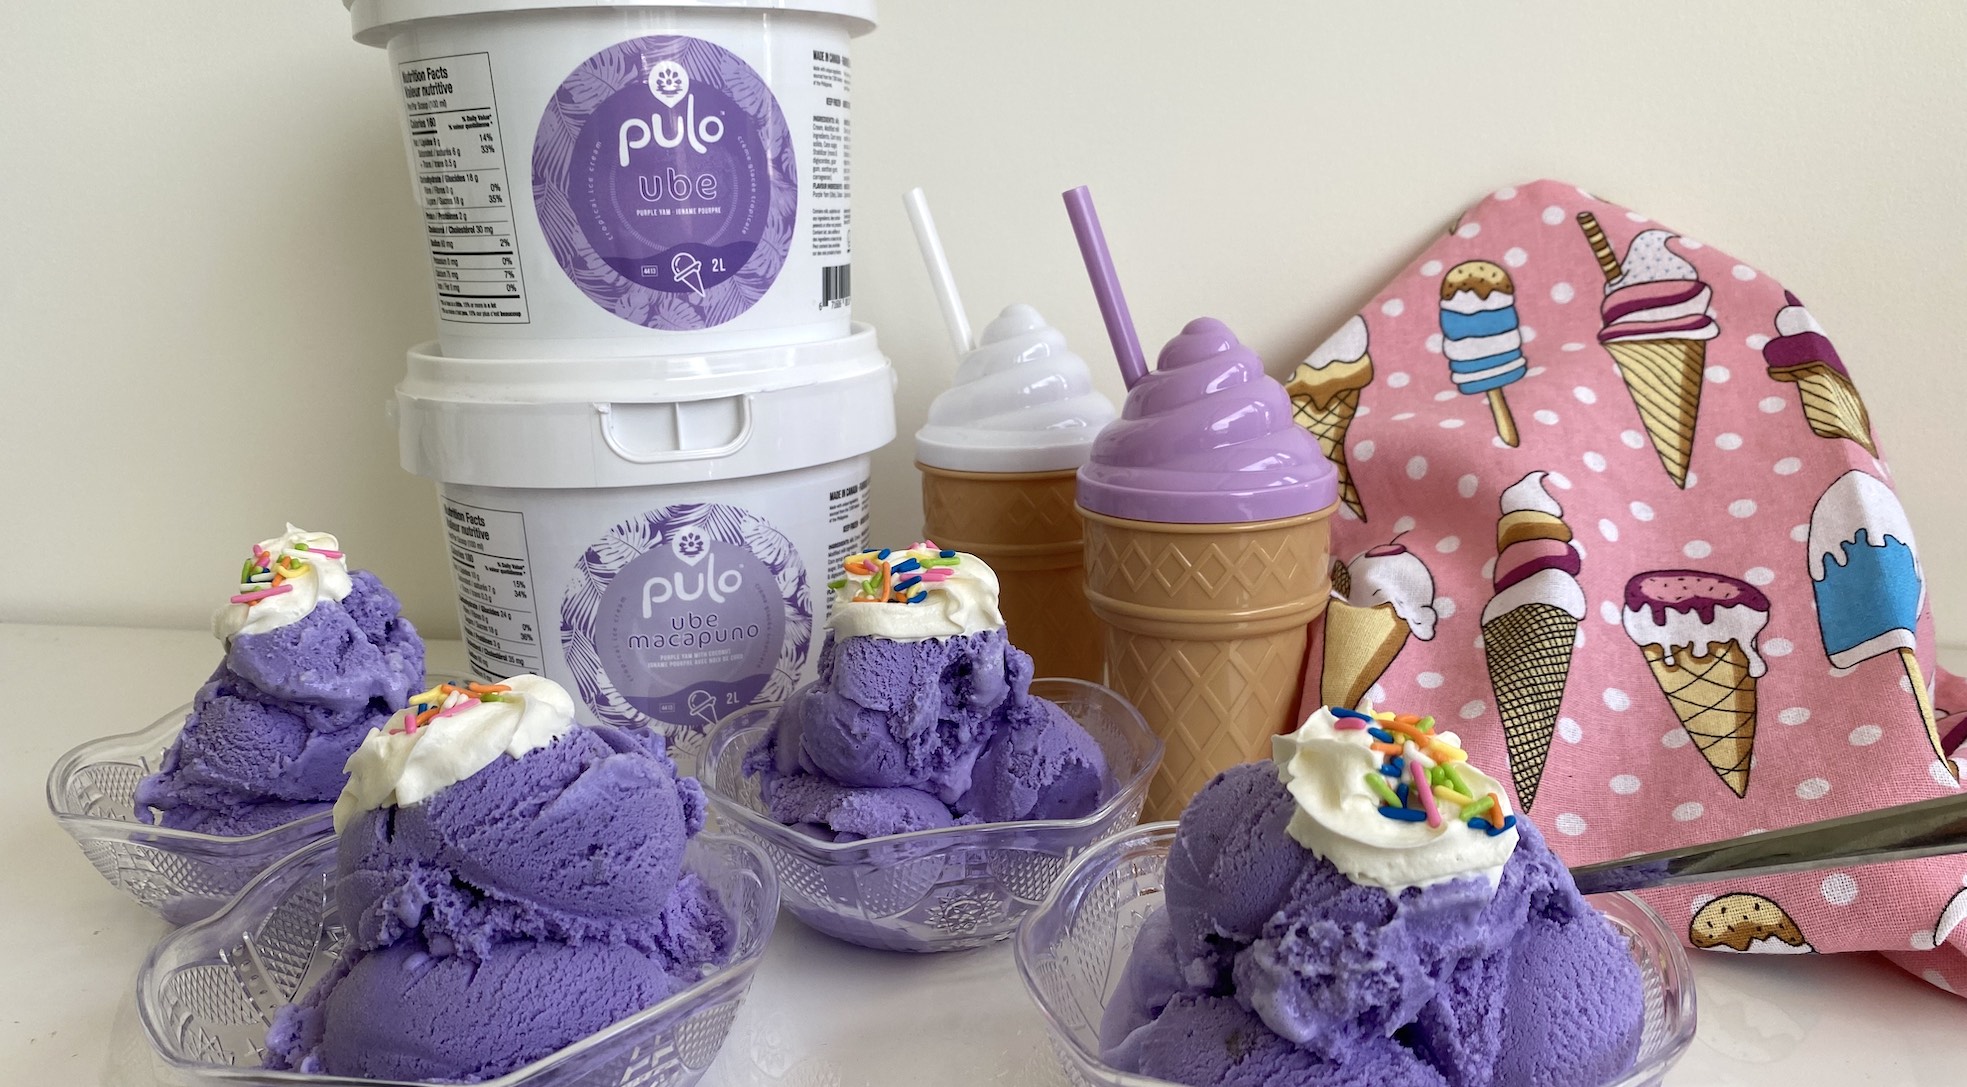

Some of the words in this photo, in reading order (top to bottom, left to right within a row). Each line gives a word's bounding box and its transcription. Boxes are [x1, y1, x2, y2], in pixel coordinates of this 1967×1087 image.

[426, 66, 448, 81] Facts
[421, 82, 453, 96] nutritive
[619, 93, 724, 167] pulo
[479, 133, 493, 142] 14%
[481, 144, 495, 154] 33%
[474, 174, 479, 183] g
[490, 183, 501, 192] 0%
[638, 167, 718, 202] ube
[489, 194, 503, 204] 35%
[698, 206, 722, 214] POURPRE
[484, 226, 494, 235] mg
[499, 238, 511, 247] 2%
[501, 257, 513, 266] 0%
[711, 258, 726, 273] 2L
[503, 270, 515, 279] 7%
[506, 283, 517, 293] 0%
[465, 512, 486, 527] Facts
[461, 525, 490, 541] nutritive
[512, 580, 526, 589] 15%
[642, 553, 743, 618] pulo
[514, 589, 527, 598] 34%
[507, 613, 512, 621] g
[670, 612, 719, 632] ube
[521, 623, 532, 632] 0%
[628, 624, 760, 649] macapuno
[515, 658, 525, 667] mg
[726, 691, 740, 705] 2L
